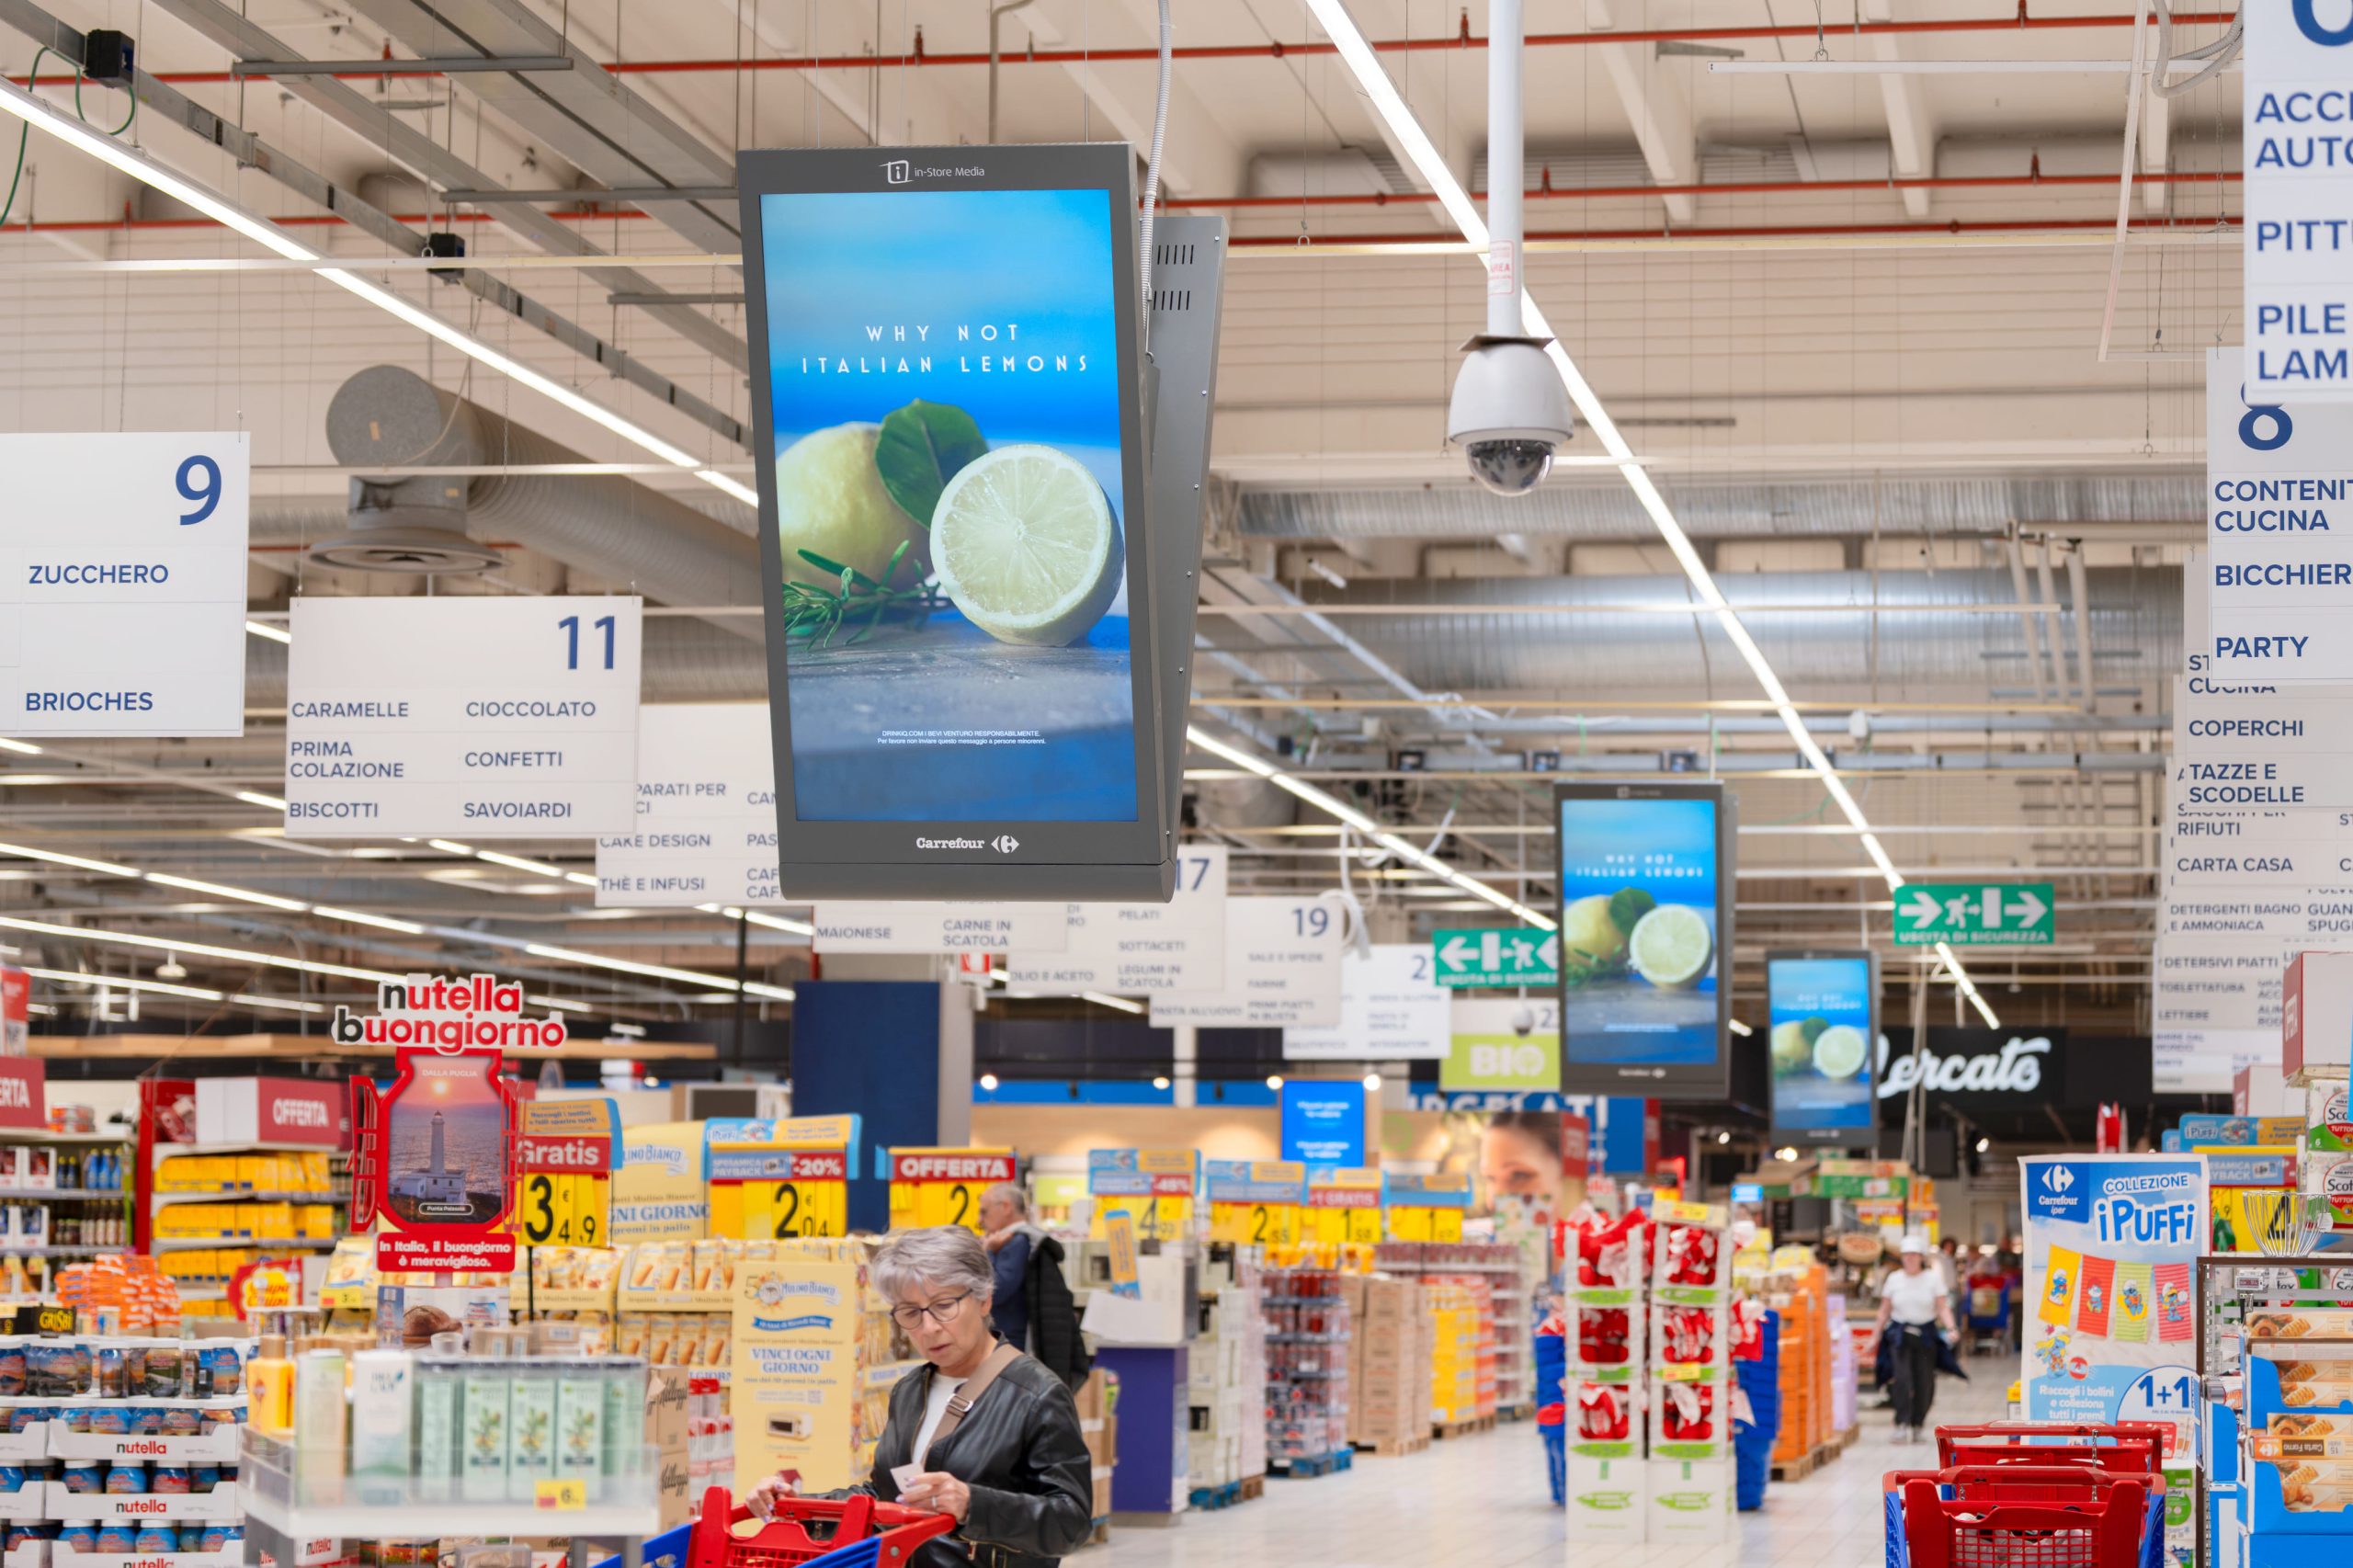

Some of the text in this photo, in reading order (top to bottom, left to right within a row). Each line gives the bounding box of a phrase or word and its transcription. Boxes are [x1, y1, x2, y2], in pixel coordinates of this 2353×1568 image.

[2255, 92, 2353, 122] ACC
[2255, 137, 2353, 167] AUT
[915, 166, 984, 177] in-Store Media
[2257, 221, 2353, 252] PITT
[2258, 304, 2346, 335] PILE
[866, 324, 1018, 342] WHY NOT
[802, 355, 1087, 374] ITALIAN LEMONS
[2258, 349, 2353, 381] LAM
[2238, 381, 2292, 450] 8
[176, 455, 222, 526] 9
[2215, 510, 2329, 531] CUCINA
[28, 564, 168, 585] ZUCCHERO
[559, 616, 614, 670] 11
[2216, 637, 2309, 658] PARTY
[26, 691, 153, 711] BRIOCHES
[291, 701, 409, 718] CARAMELLE
[465, 700, 597, 718] CIOCCOLATO
[2188, 721, 2303, 736] COPERCHI
[290, 742, 353, 757] PRIMA
[464, 751, 563, 767] CONFETTI
[290, 762, 404, 778] COLAZIONE
[2189, 764, 2277, 779] TAZZE E
[696, 784, 726, 796] PER
[2189, 787, 2303, 802] SCODELLE
[290, 802, 379, 818] BISCOTTI
[463, 801, 572, 818] SAVOIARDI
[2177, 822, 2240, 835] RIFIUTI
[649, 835, 710, 847] DESIGN
[916, 837, 984, 849] Carrefour
[2177, 858, 2293, 871] CARTA CASA
[600, 876, 705, 891] THÈ E INFUSI
[1119, 910, 1159, 920] PELATI
[2170, 904, 2301, 915] DETERGENTI BAGNO
[943, 920, 1010, 931] CARNE IN
[1291, 907, 1328, 937] 19
[2171, 921, 2264, 931] E AMMONIACA
[2308, 920, 2353, 932] SPUG
[816, 926, 891, 938] MAIONESE
[1899, 932, 1949, 942] USCITA
[1970, 932, 2048, 942] SICUREZZA
[943, 935, 1008, 947] SCATOLA
[1118, 941, 1185, 951] SOTTACETI
[1118, 965, 1181, 975] LEGUMI IN
[2165, 958, 2278, 969] DETERSIVI PIATTI
[1053, 971, 1094, 982] ACETO
[1119, 978, 1174, 988] SCATOLA
[383, 977, 520, 1012] nutella
[337, 1008, 563, 1051] buongiorno
[1471, 1044, 1545, 1076] BIO
[273, 1098, 329, 1127] OFFERTA
[517, 1140, 599, 1165] Gratis
[900, 1159, 1008, 1177] OFFERTA
[2106, 1175, 2188, 1193] COLLEZIONE
[2039, 1195, 2078, 1205] Carrefour
[525, 1175, 553, 1243] 3
[775, 1183, 798, 1238] 2
[2051, 1206, 2066, 1215] iper
[380, 1241, 511, 1256] In Italia, il buongiorno
[398, 1255, 492, 1269] è meraviglioso.
[752, 1348, 831, 1360] VINCI OGNI
[763, 1362, 819, 1373] GIORNO
[2040, 1385, 2079, 1397] Raccogli
[2086, 1385, 2114, 1395] bollini
[2059, 1398, 2105, 1408] colleziona
[2050, 1410, 2069, 1419] tutti
[116, 1441, 167, 1455] nutella
[116, 1500, 167, 1513] nutella
